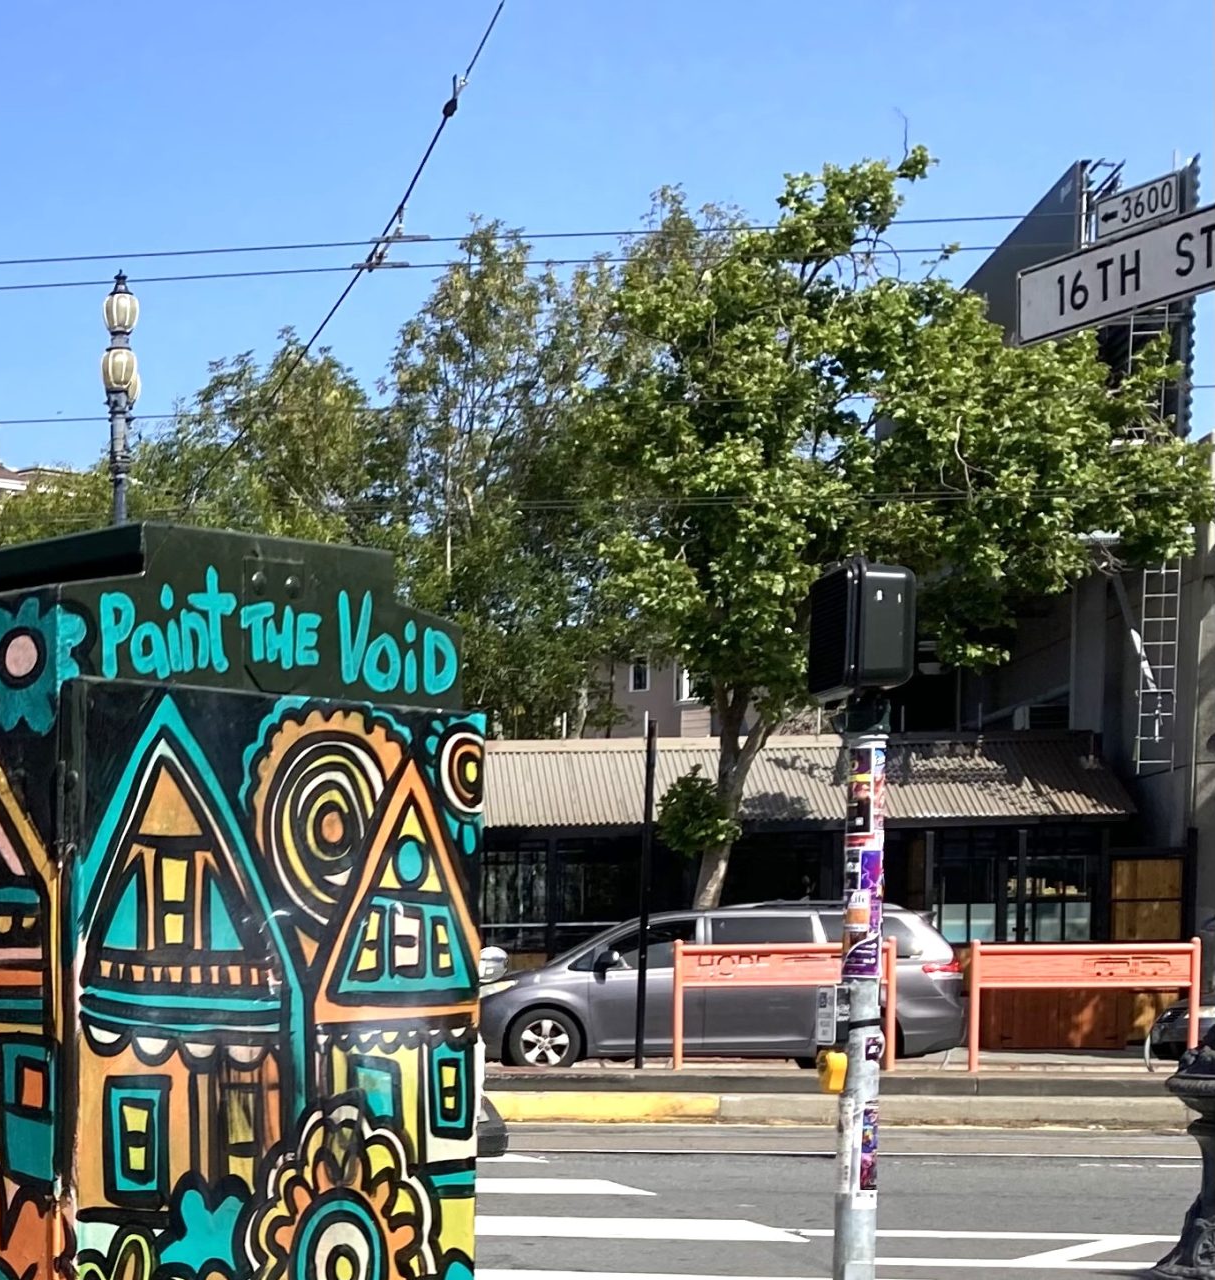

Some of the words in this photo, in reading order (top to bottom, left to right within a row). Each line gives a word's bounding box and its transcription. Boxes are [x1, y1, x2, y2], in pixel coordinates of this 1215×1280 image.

[1121, 180, 1171, 223] 3600
[1057, 248, 1141, 317] 16TH
[1175, 222, 1215, 278] ST
[99, 565, 237, 680] Paint
[241, 601, 323, 670] THE
